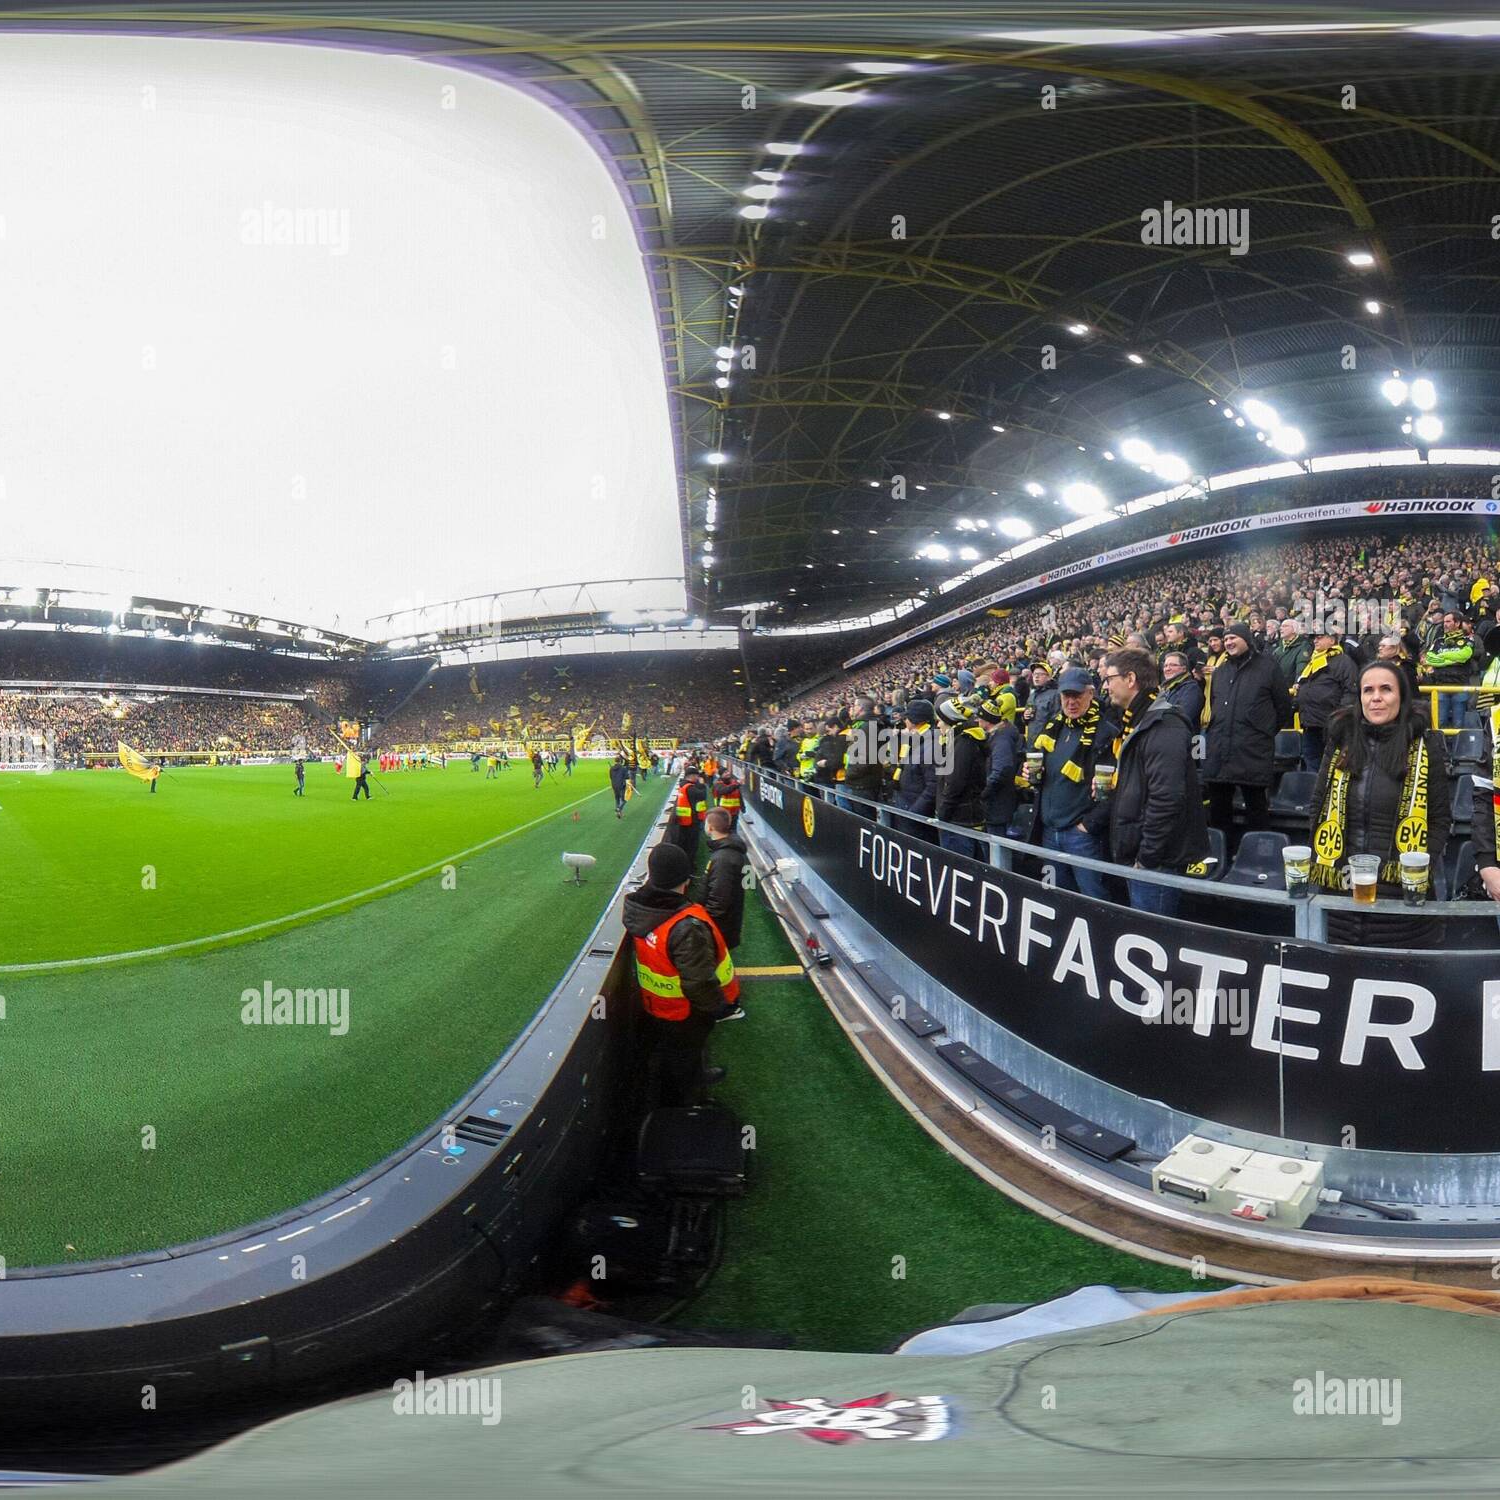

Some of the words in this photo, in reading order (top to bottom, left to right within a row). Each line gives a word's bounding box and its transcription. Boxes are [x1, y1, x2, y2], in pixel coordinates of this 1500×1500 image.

[1259, 506, 1351, 526] hankookreifen.de
[1318, 825, 1342, 851] BVB
[1400, 821, 1428, 848] BVB
[1323, 846, 1333, 856] 09
